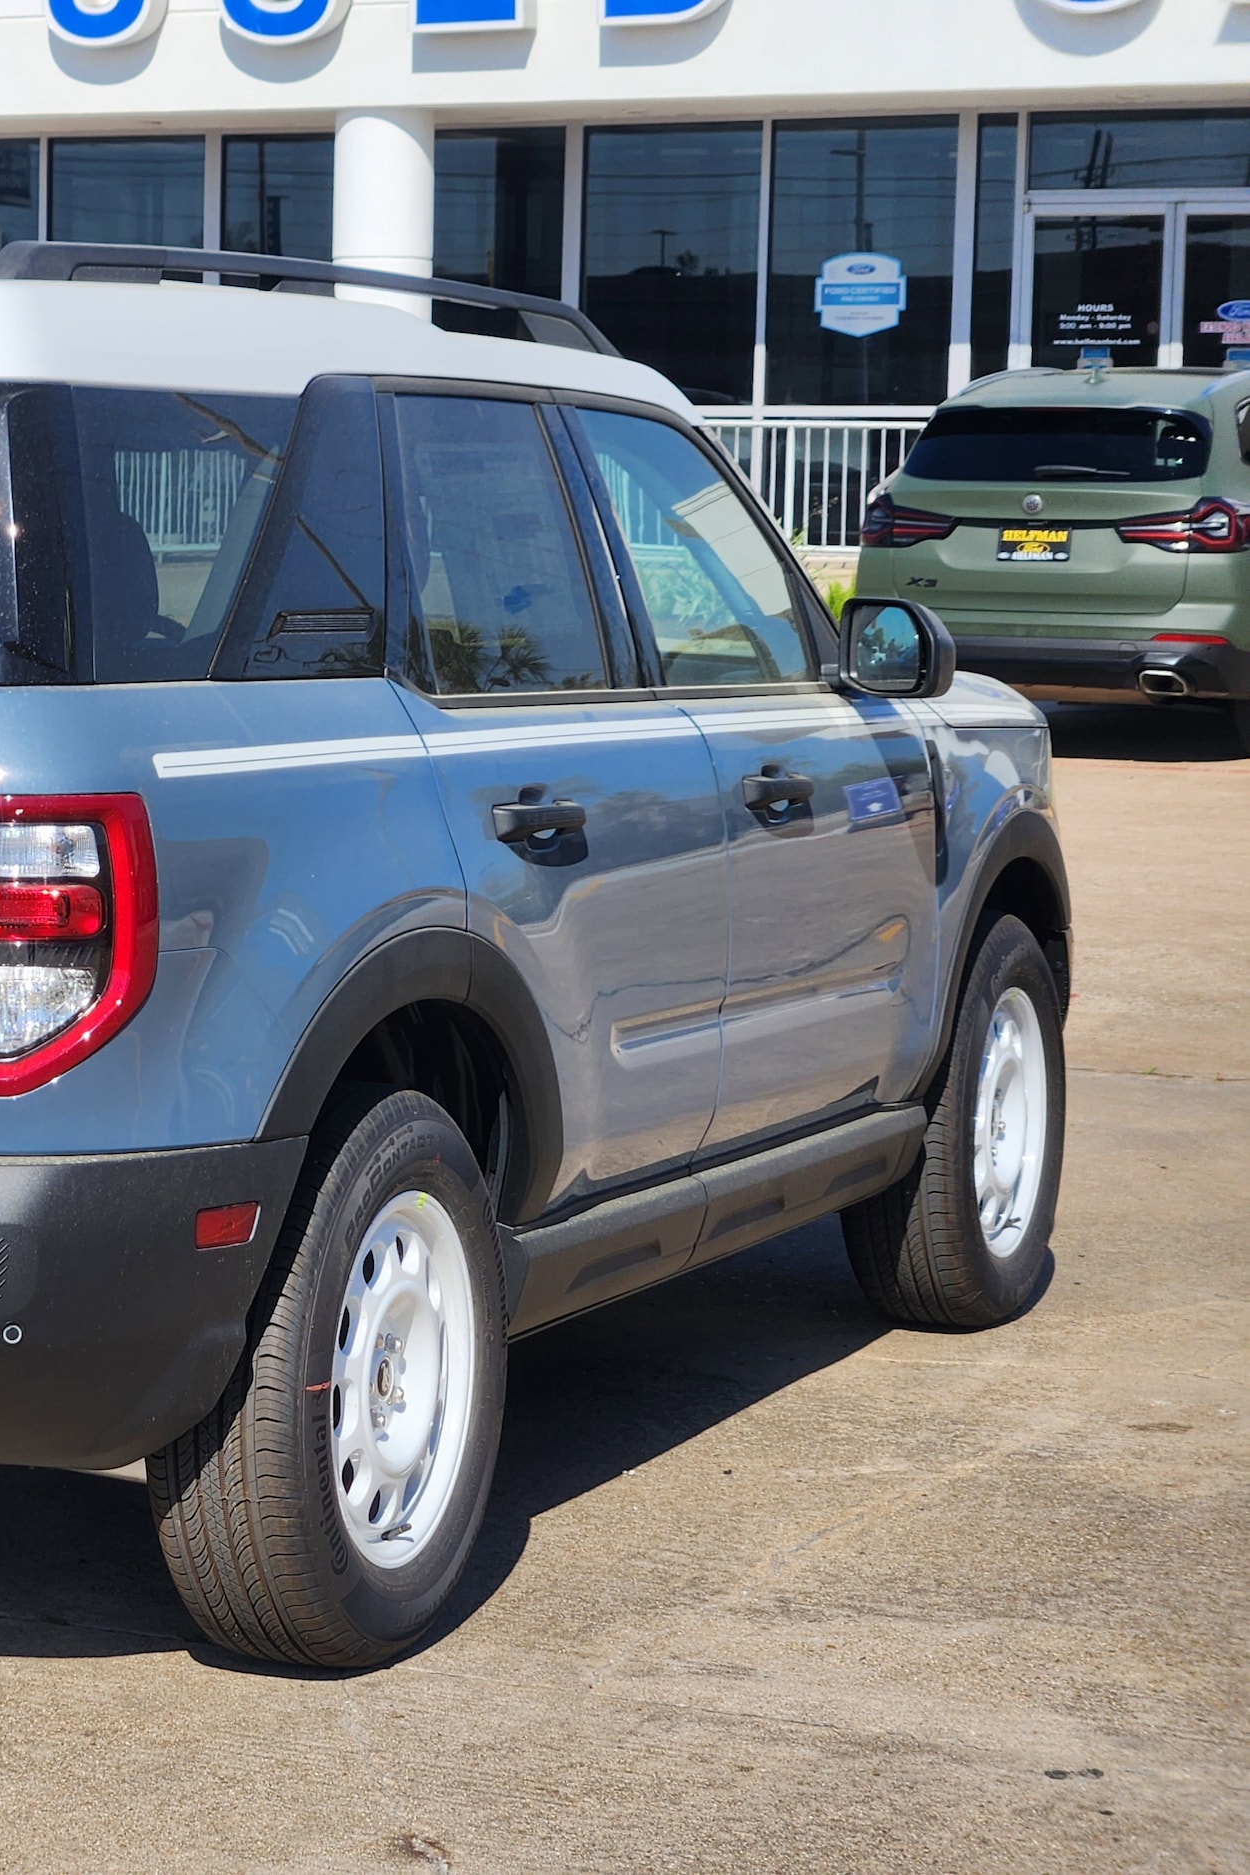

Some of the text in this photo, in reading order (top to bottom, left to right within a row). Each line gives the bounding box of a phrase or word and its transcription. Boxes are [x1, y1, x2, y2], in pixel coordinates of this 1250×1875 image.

[1077, 303, 1114, 312] HOURS
[1059, 313, 1090, 322] Monday
[1096, 313, 1132, 322] Saturday
[905, 576, 938, 588] X3
